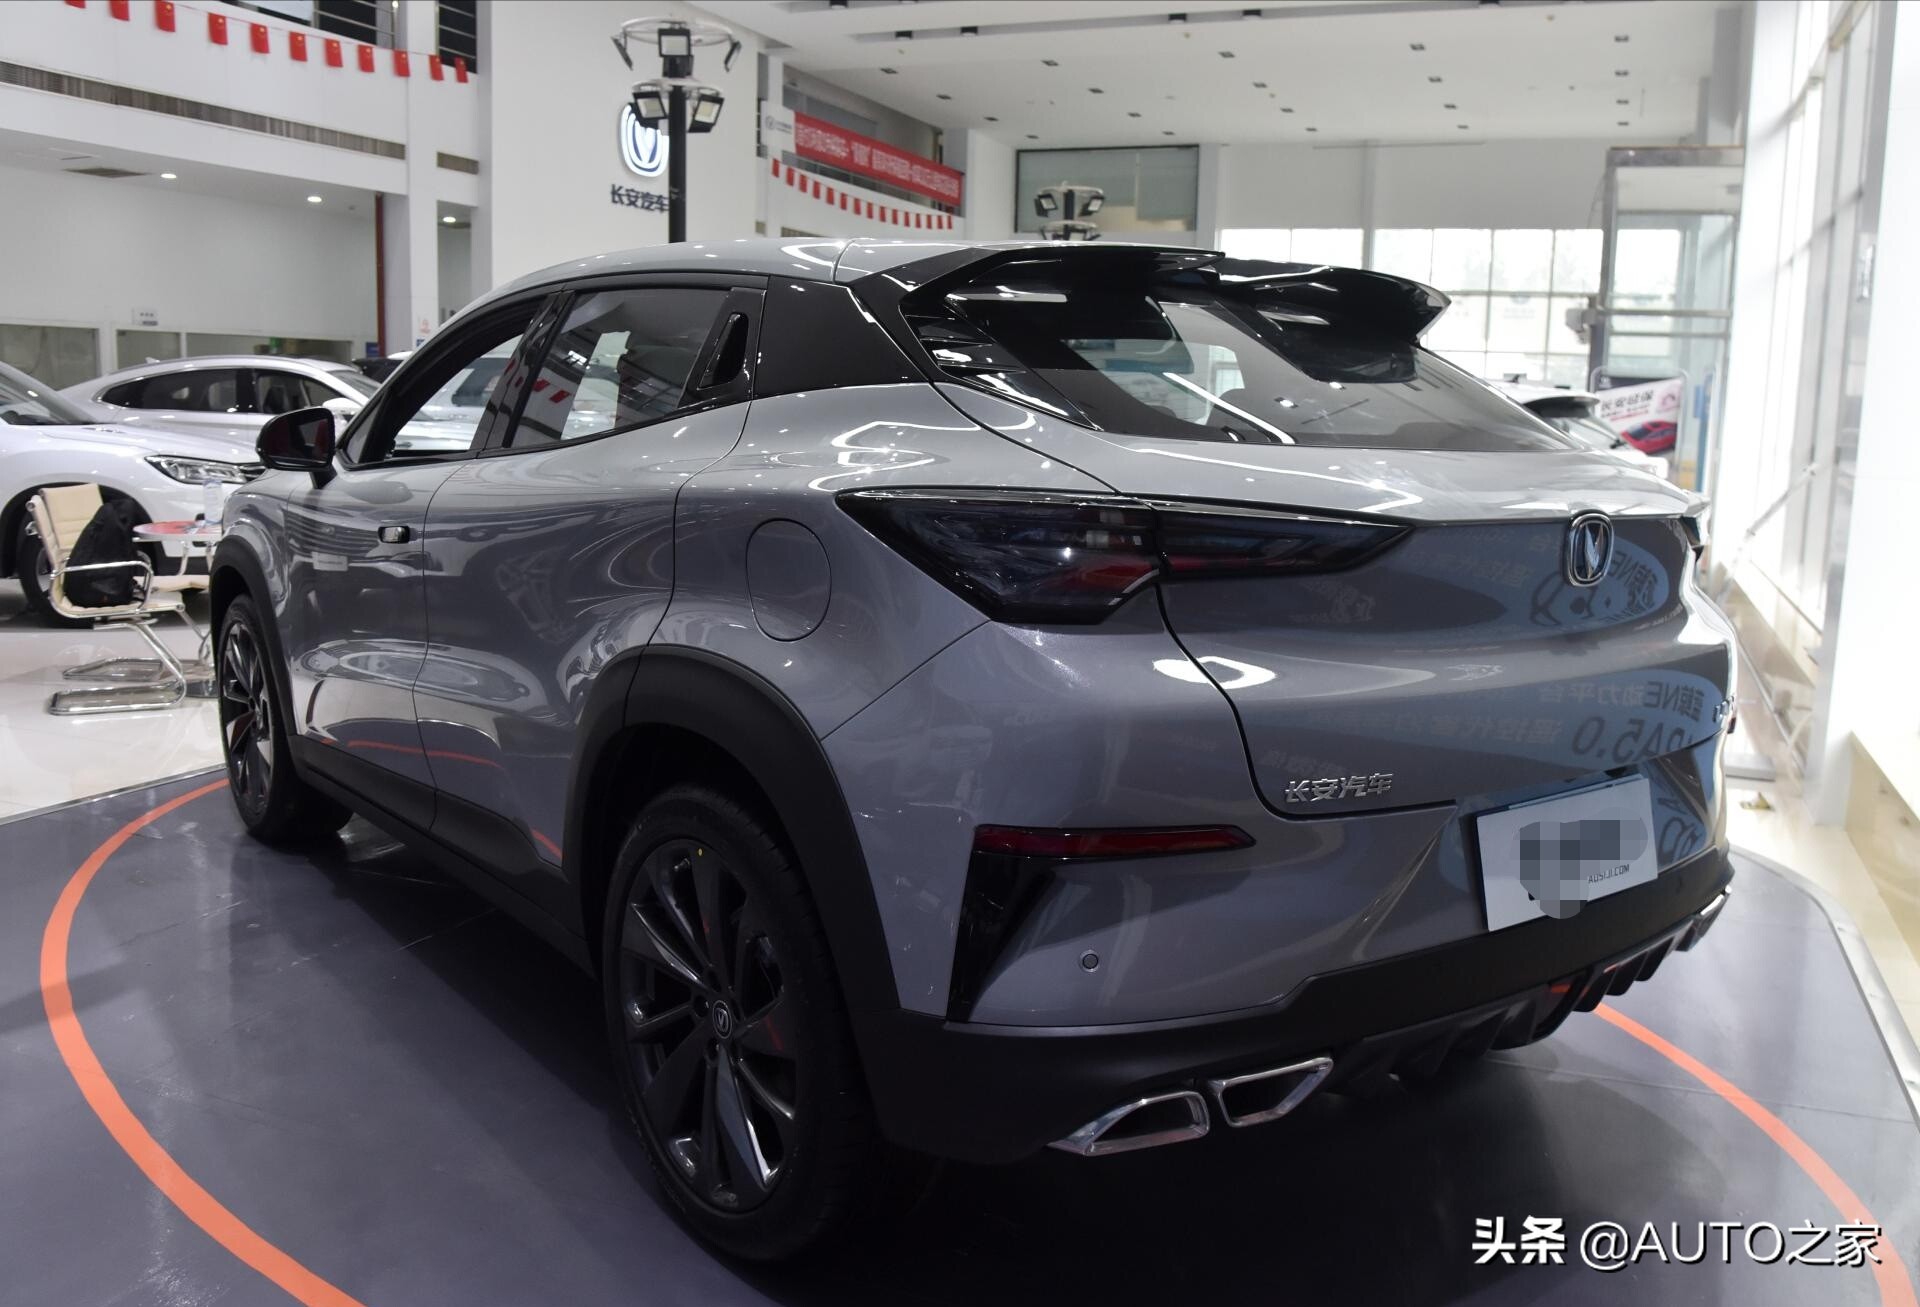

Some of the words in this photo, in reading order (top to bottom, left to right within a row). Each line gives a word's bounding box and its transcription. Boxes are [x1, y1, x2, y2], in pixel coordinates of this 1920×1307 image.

[611, 184, 669, 213] 长安汽车
[1285, 773, 1394, 803] 长安汽车
